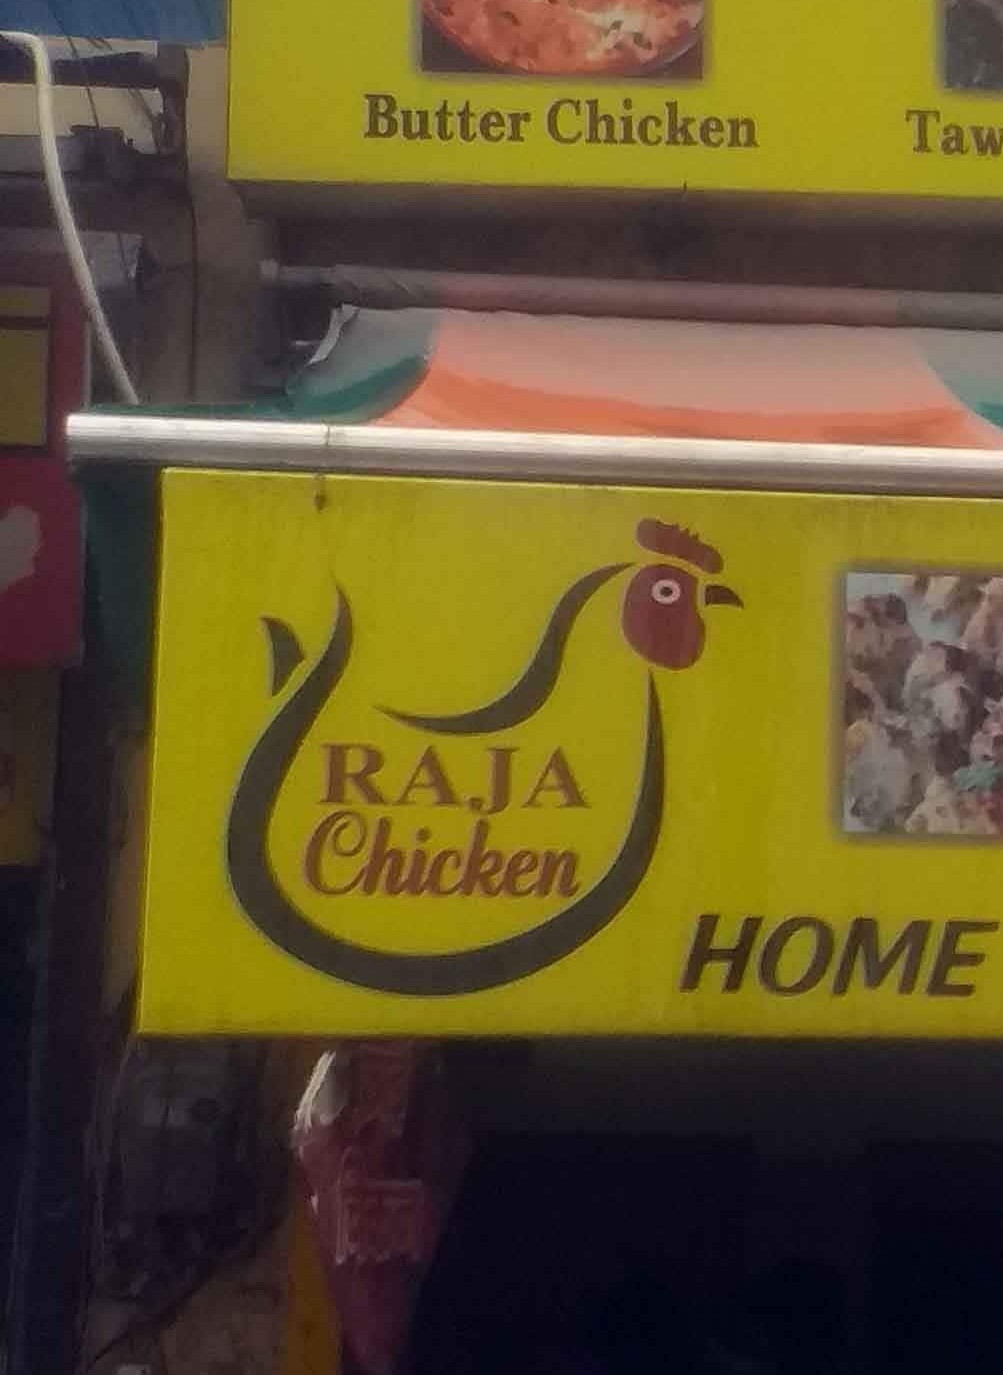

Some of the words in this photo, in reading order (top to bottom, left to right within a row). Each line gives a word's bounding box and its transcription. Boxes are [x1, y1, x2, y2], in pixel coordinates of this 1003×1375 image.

[363, 93, 531, 142] Butter
[548, 98, 759, 148] Chicken
[318, 743, 591, 814] RAJA
[304, 810, 581, 897] Chicken
[679, 913, 1000, 997] HOME
